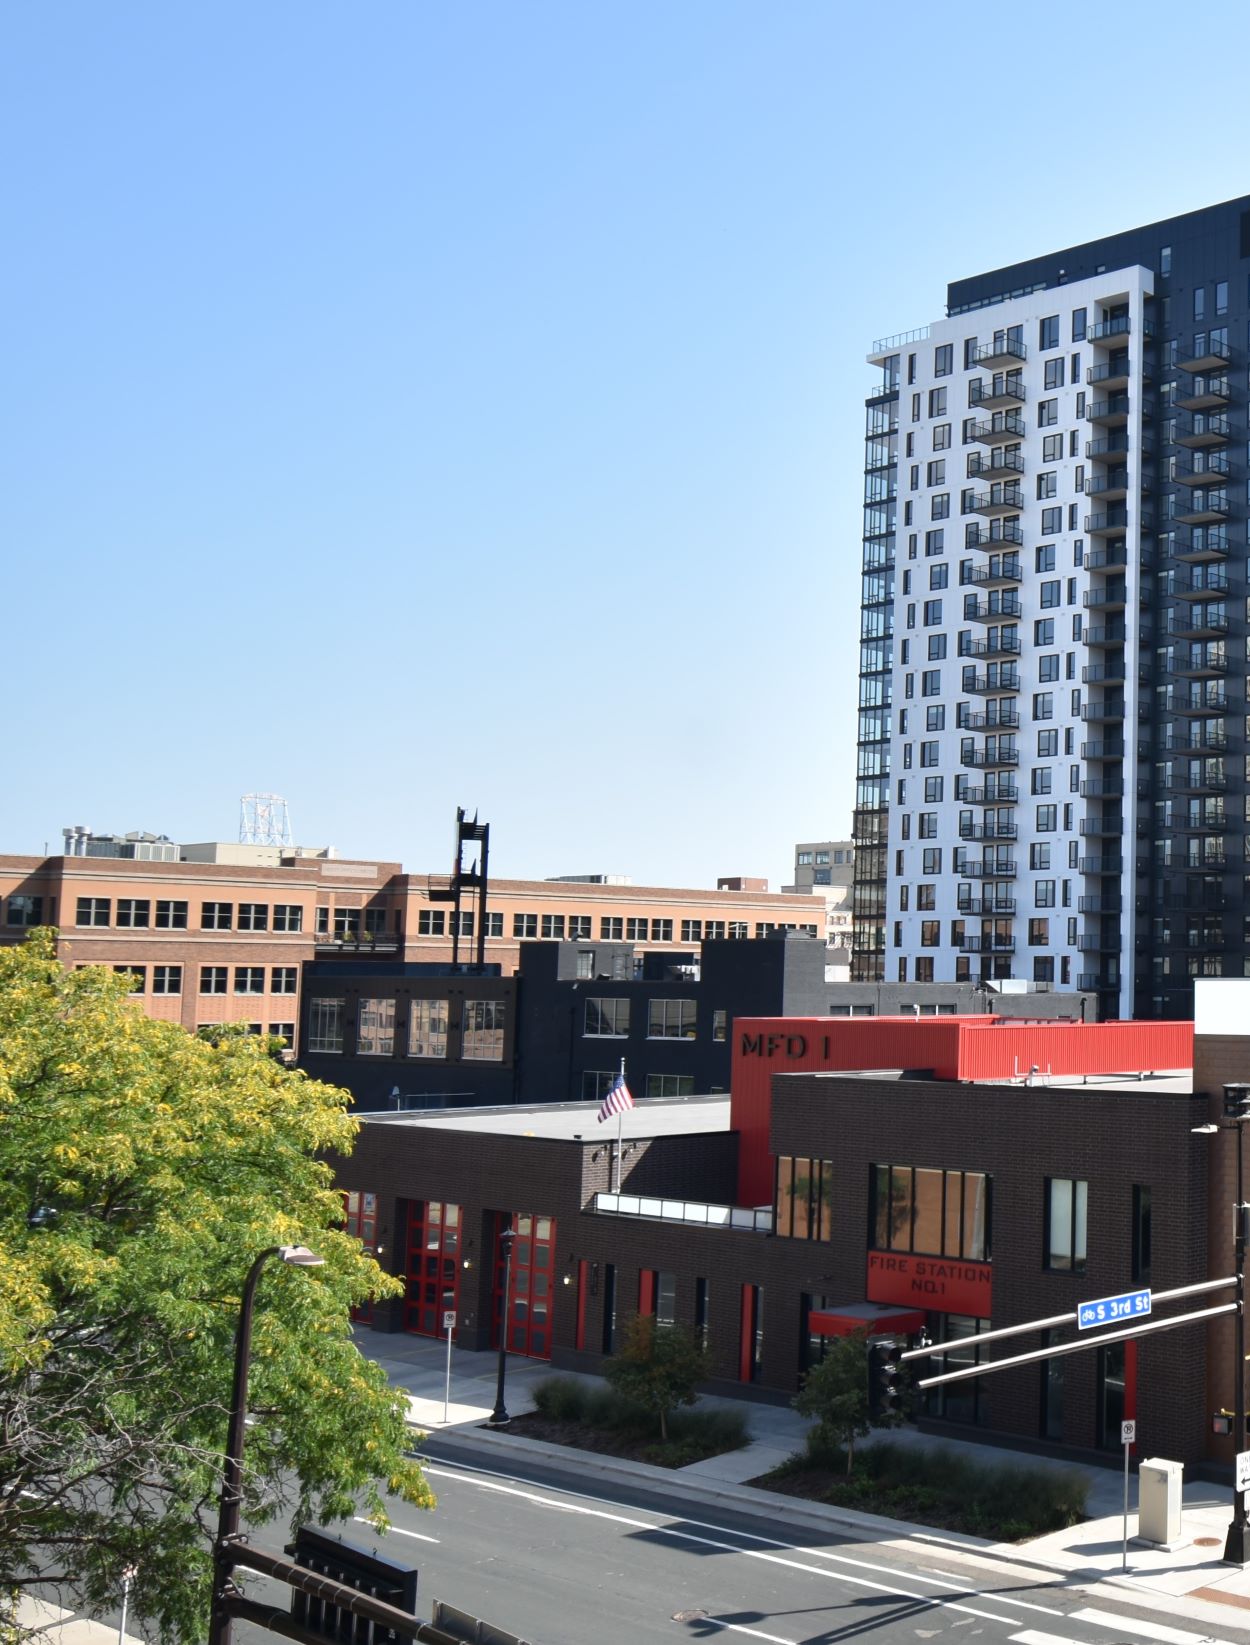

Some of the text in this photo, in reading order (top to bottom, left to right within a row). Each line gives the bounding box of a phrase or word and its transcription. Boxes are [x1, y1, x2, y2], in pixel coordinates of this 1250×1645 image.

[742, 1032, 807, 1060] MFD
[869, 1256, 992, 1284] FIRE STATION
[1097, 1295, 1149, 1320] S 3rd St
